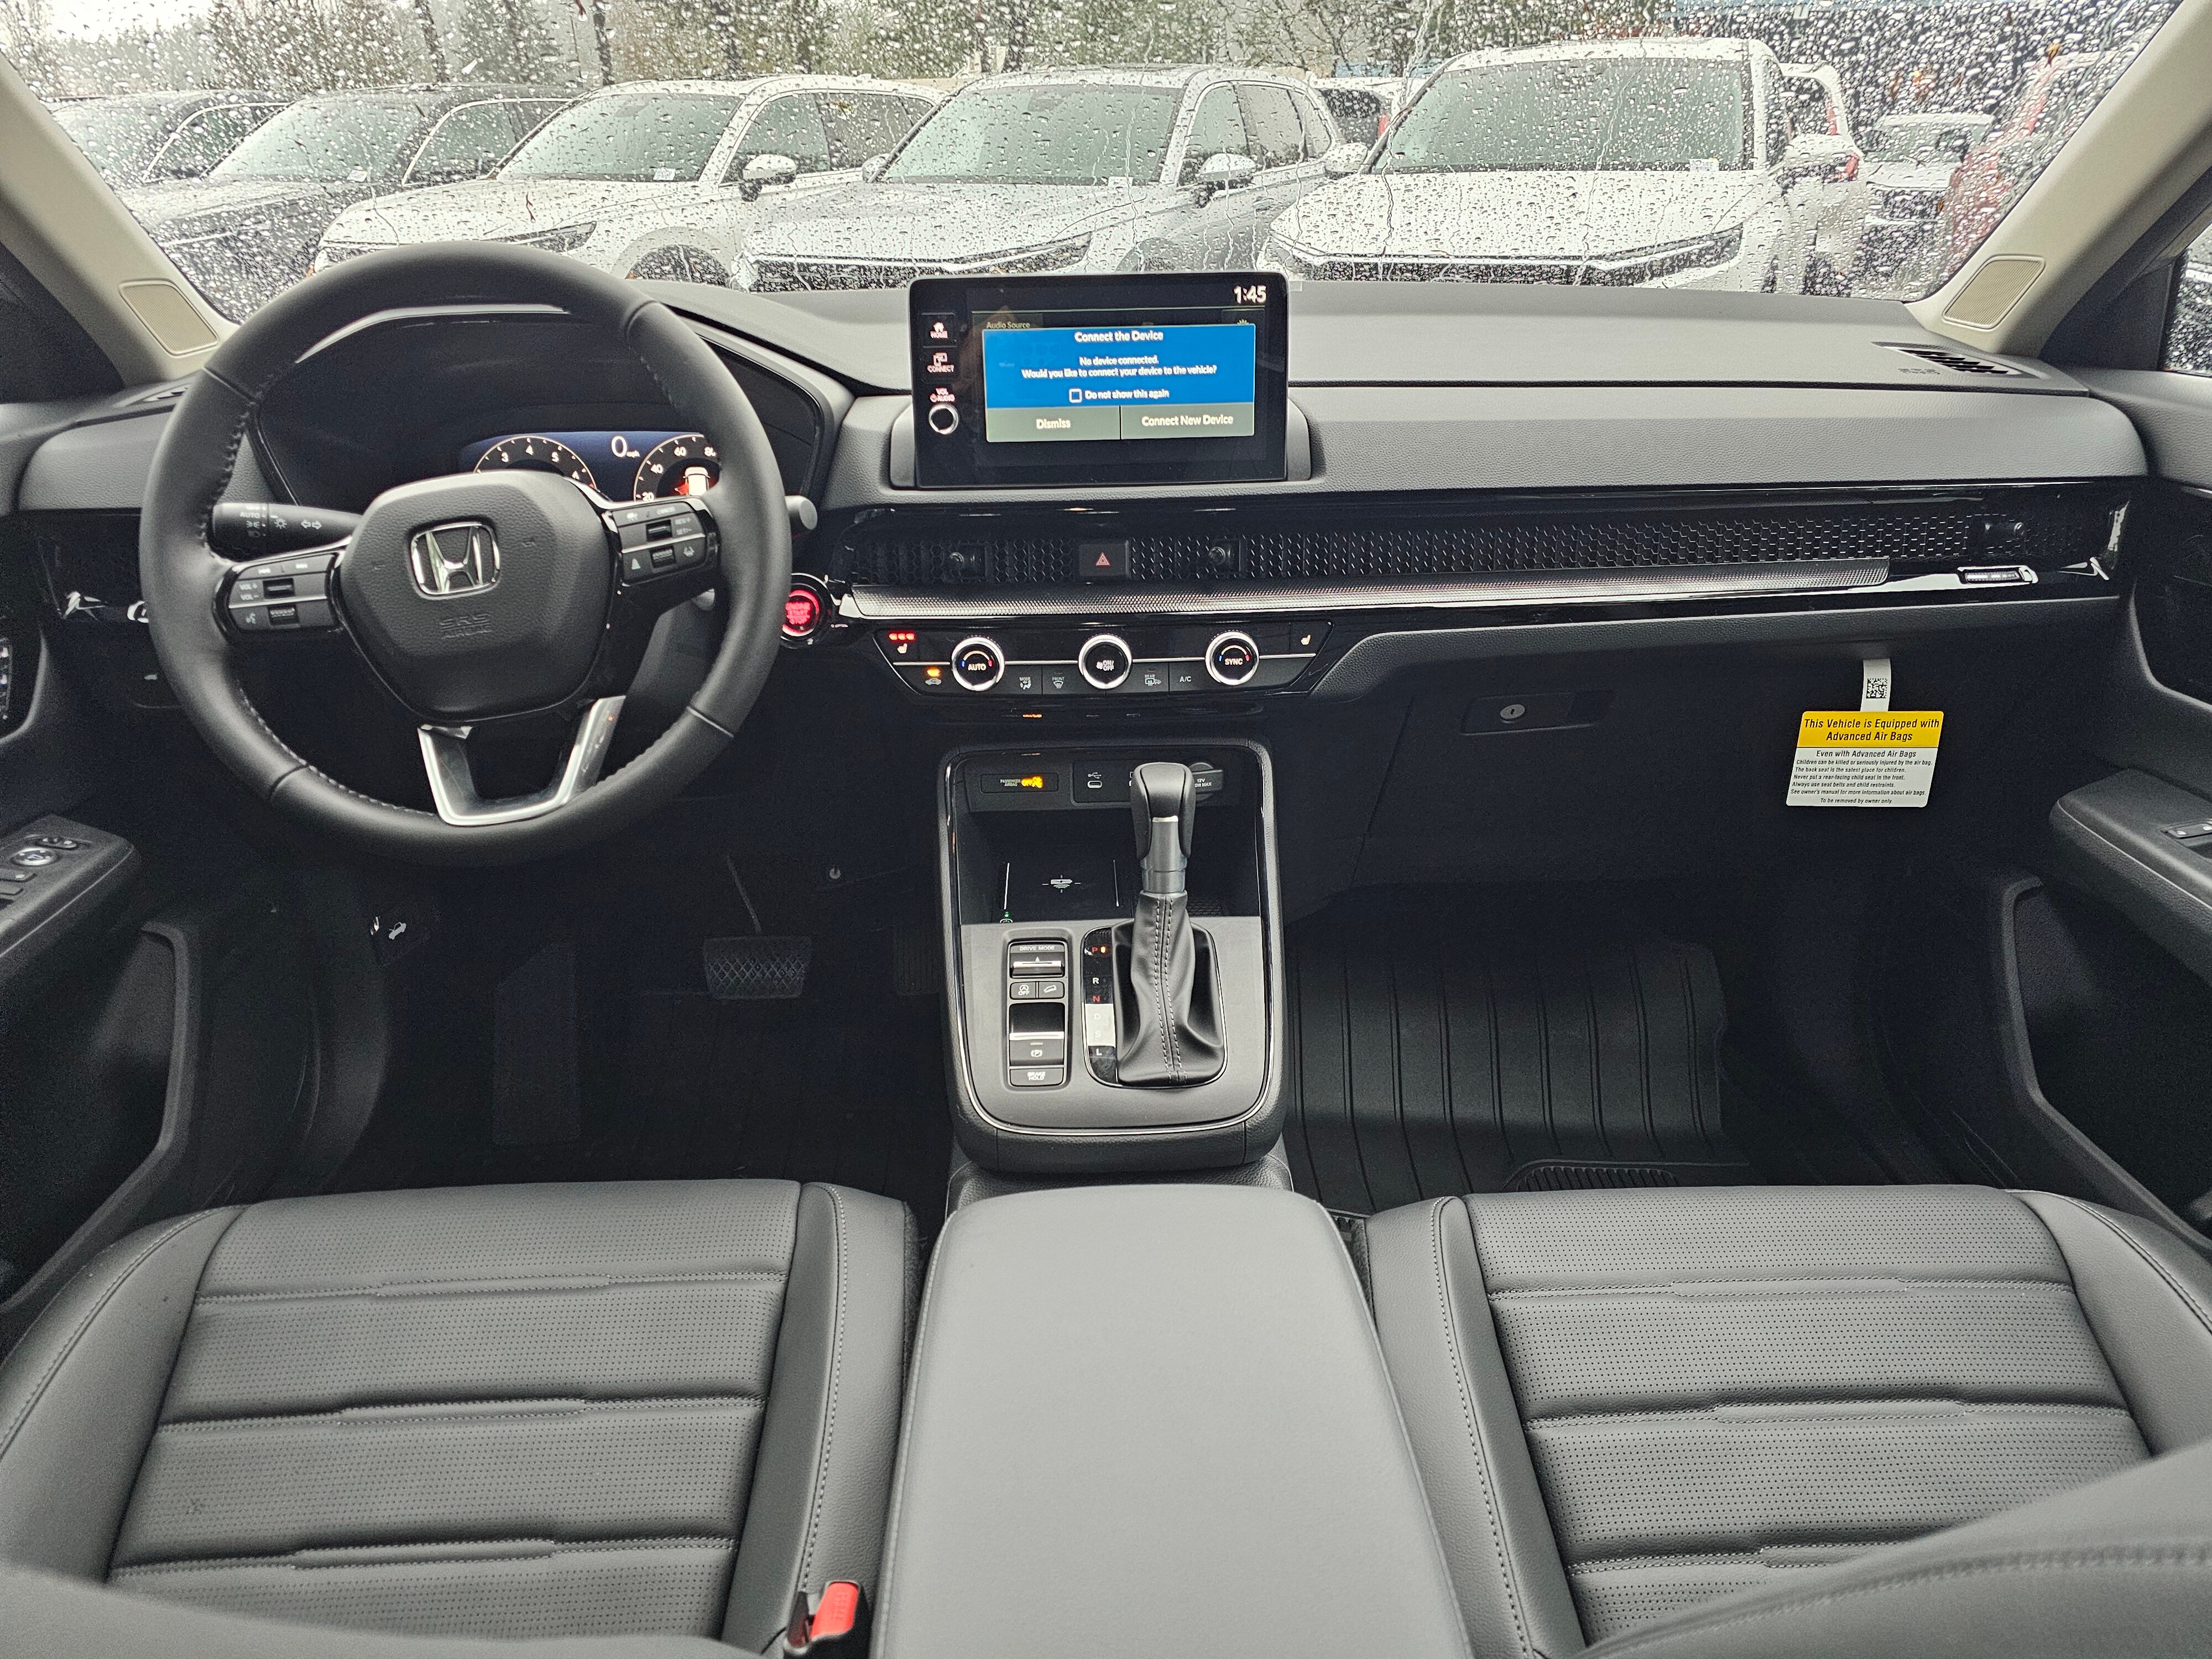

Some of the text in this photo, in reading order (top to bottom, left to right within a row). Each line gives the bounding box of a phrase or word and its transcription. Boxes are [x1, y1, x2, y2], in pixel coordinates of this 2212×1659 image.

[1234, 285, 1266, 304] 1:45
[1074, 330, 1164, 342] Connect the Device
[1079, 354, 1159, 366] No device connected.
[1021, 365, 1217, 379] Would you like to connect your device to the vehicle?
[1084, 389, 1170, 400] Do not show this again
[1036, 418, 1071, 430] Dismiss
[1141, 414, 1234, 427] Connect New Device
[525, 445, 534, 455] 4
[674, 446, 687, 456] 60
[500, 452, 509, 462] 3
[551, 452, 559, 462] 5
[650, 464, 663, 474] 40
[642, 492, 655, 502] 20
[1804, 719, 1939, 729] This Vehicle is Equipped with
[1826, 732, 1913, 742] Advanced Air Bags
